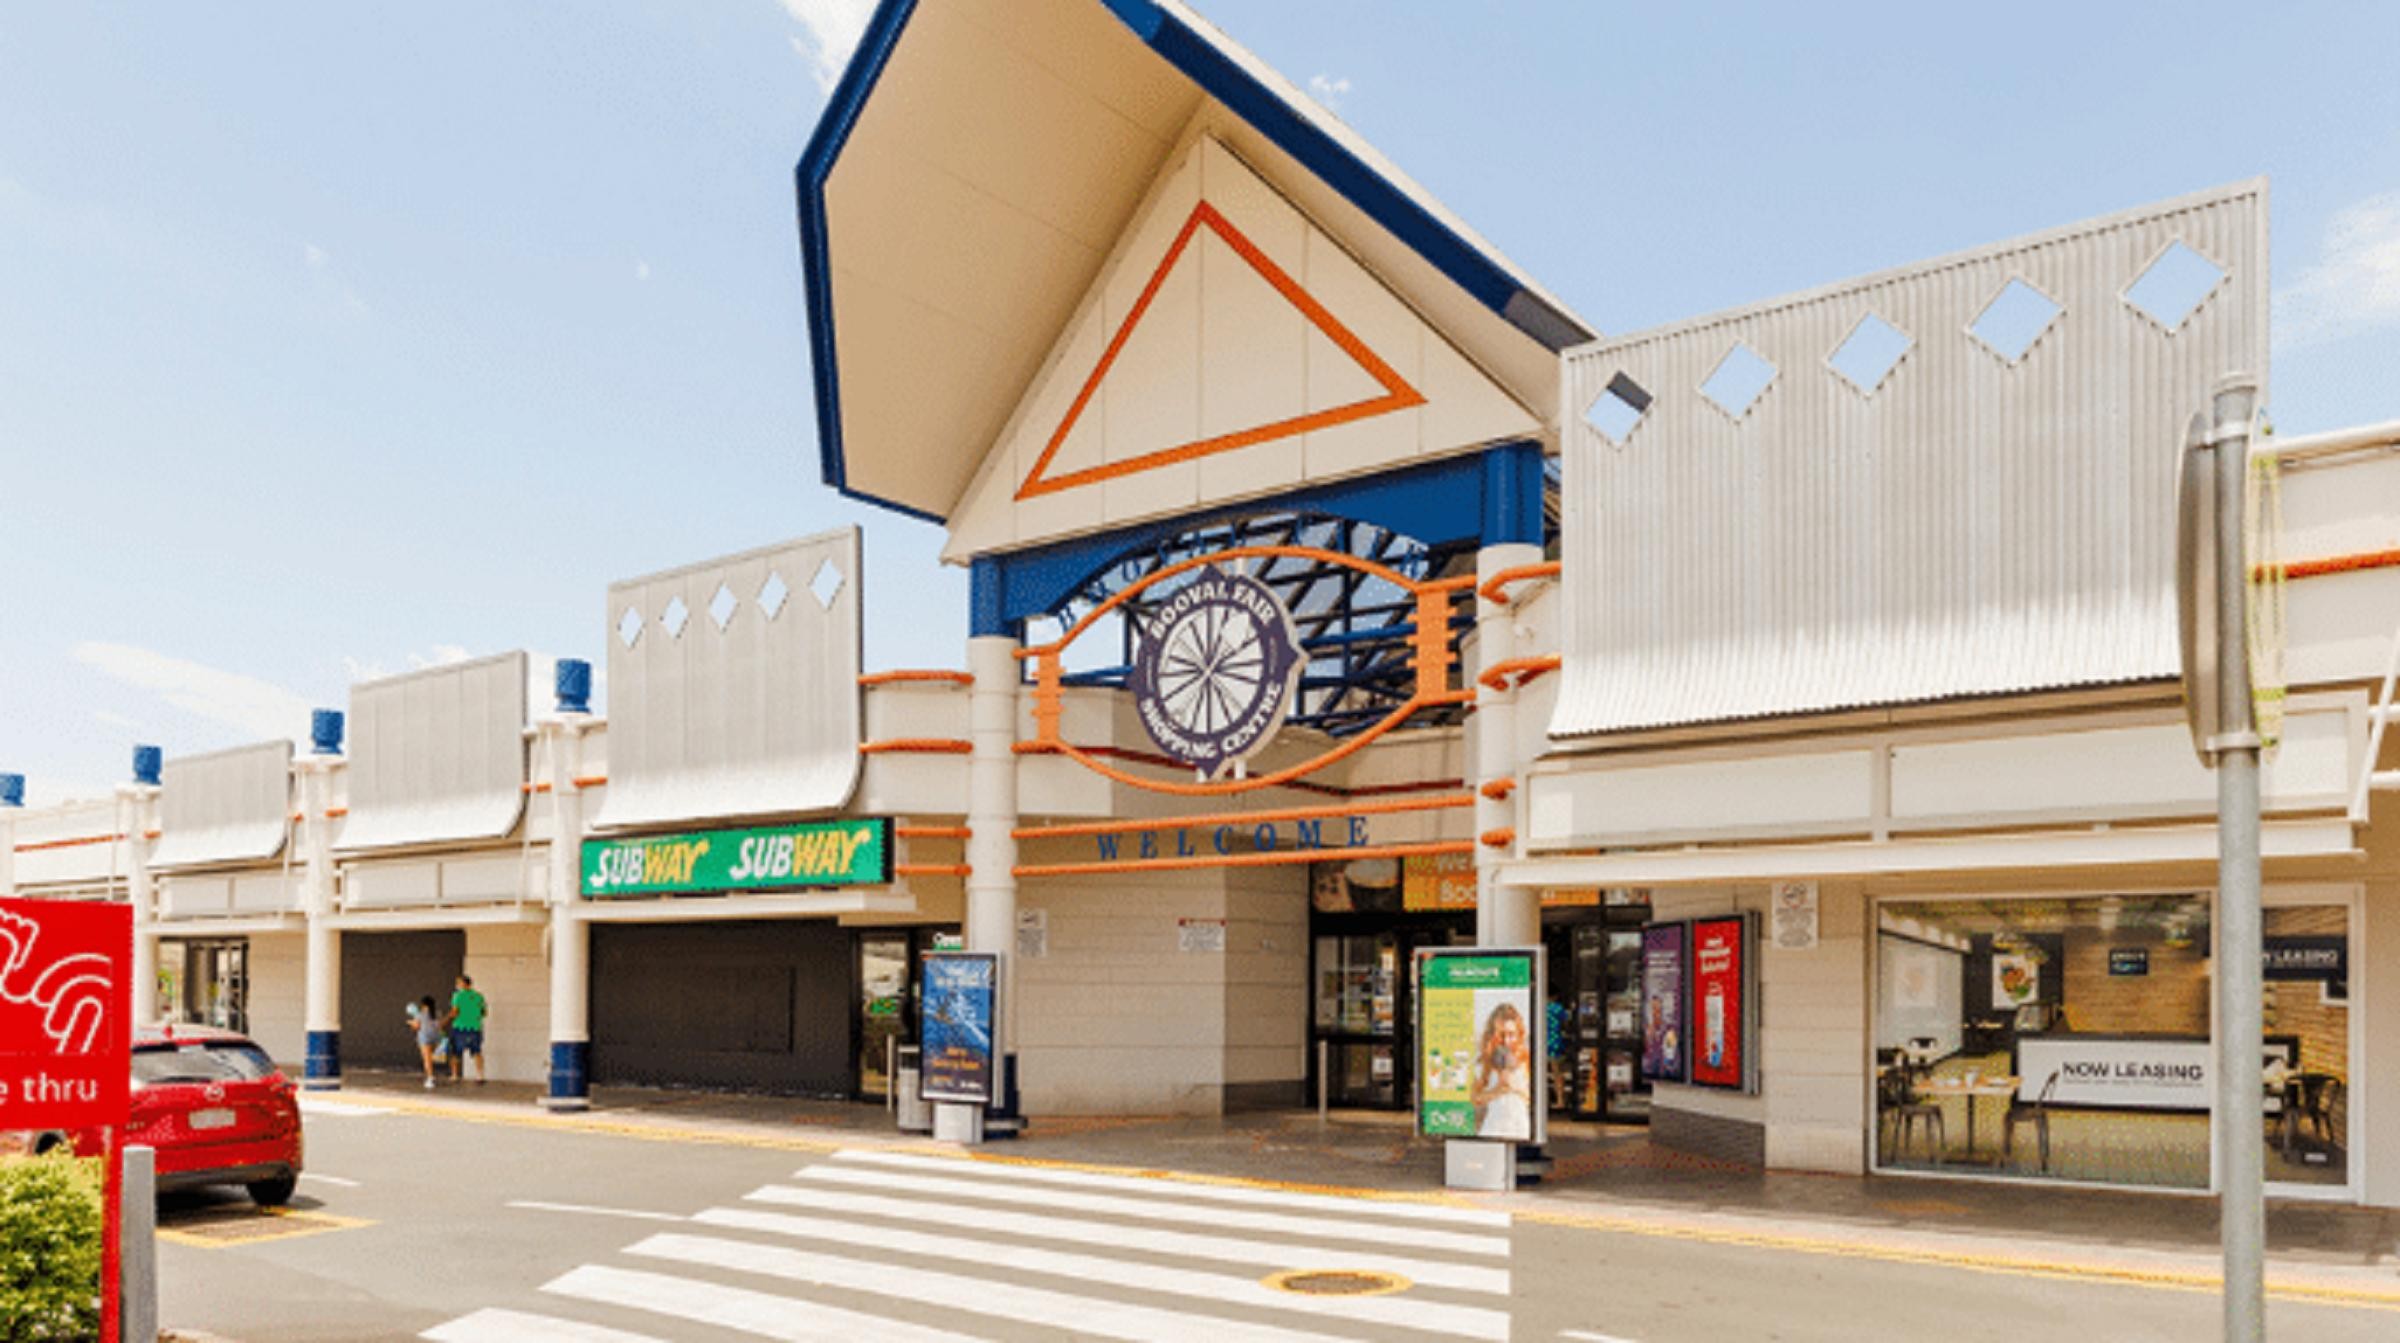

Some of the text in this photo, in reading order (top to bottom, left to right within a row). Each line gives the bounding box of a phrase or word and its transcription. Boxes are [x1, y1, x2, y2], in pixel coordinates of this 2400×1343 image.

[1151, 581, 1276, 640] BOOVAL FAIR
[1141, 681, 1281, 758] SHOPPING CENTRE
[729, 829, 871, 881] SUBWAY
[1096, 816, 1370, 861] WELCOME
[589, 840, 710, 888] SUBWAY
[23, 1072, 98, 1103] thru
[2062, 1062, 2204, 1081] NOW LEASING
